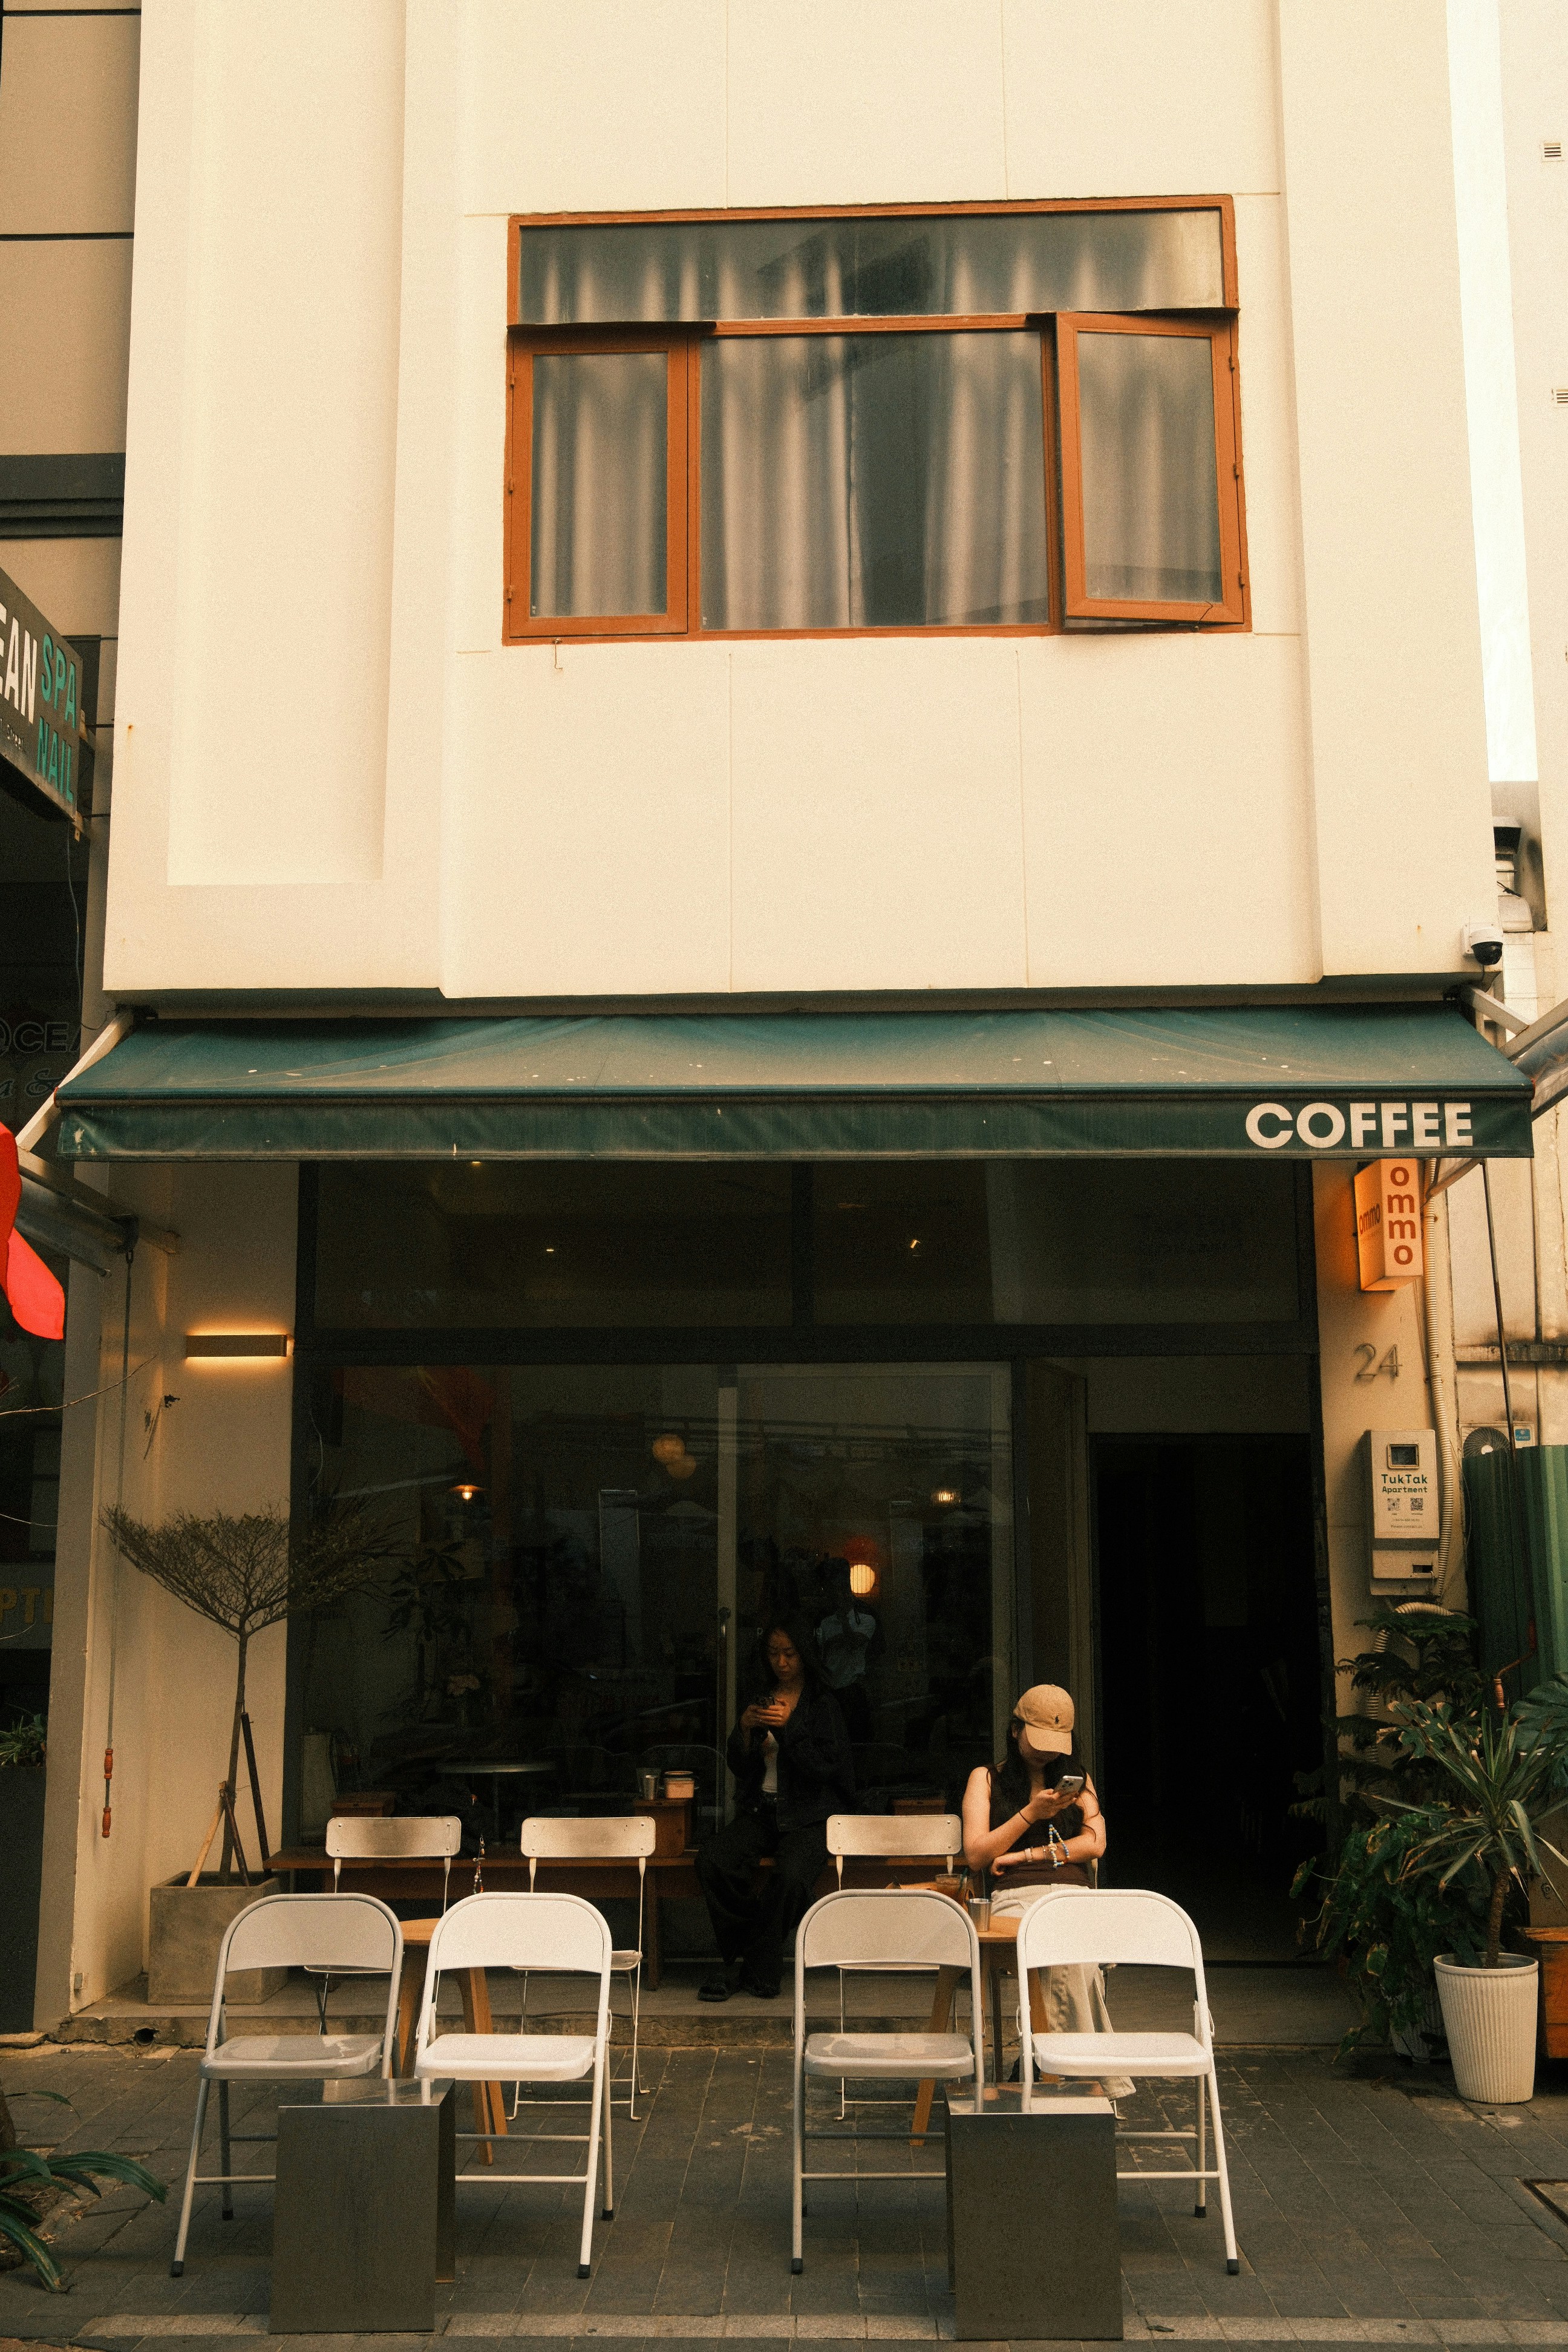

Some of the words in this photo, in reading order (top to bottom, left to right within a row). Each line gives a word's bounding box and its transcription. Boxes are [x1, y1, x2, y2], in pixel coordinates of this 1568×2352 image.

[41, 633, 76, 729] SPA
[37, 716, 73, 804] NAIL
[1246, 1102, 1473, 1149] COFFEE
[1359, 1203, 1380, 1235] ommo
[1387, 1166, 1416, 1265] ommo
[1354, 1342, 1403, 1379] 24
[1381, 1474, 1428, 1484] TukTak
[1382, 1486, 1428, 1494] Apartment
